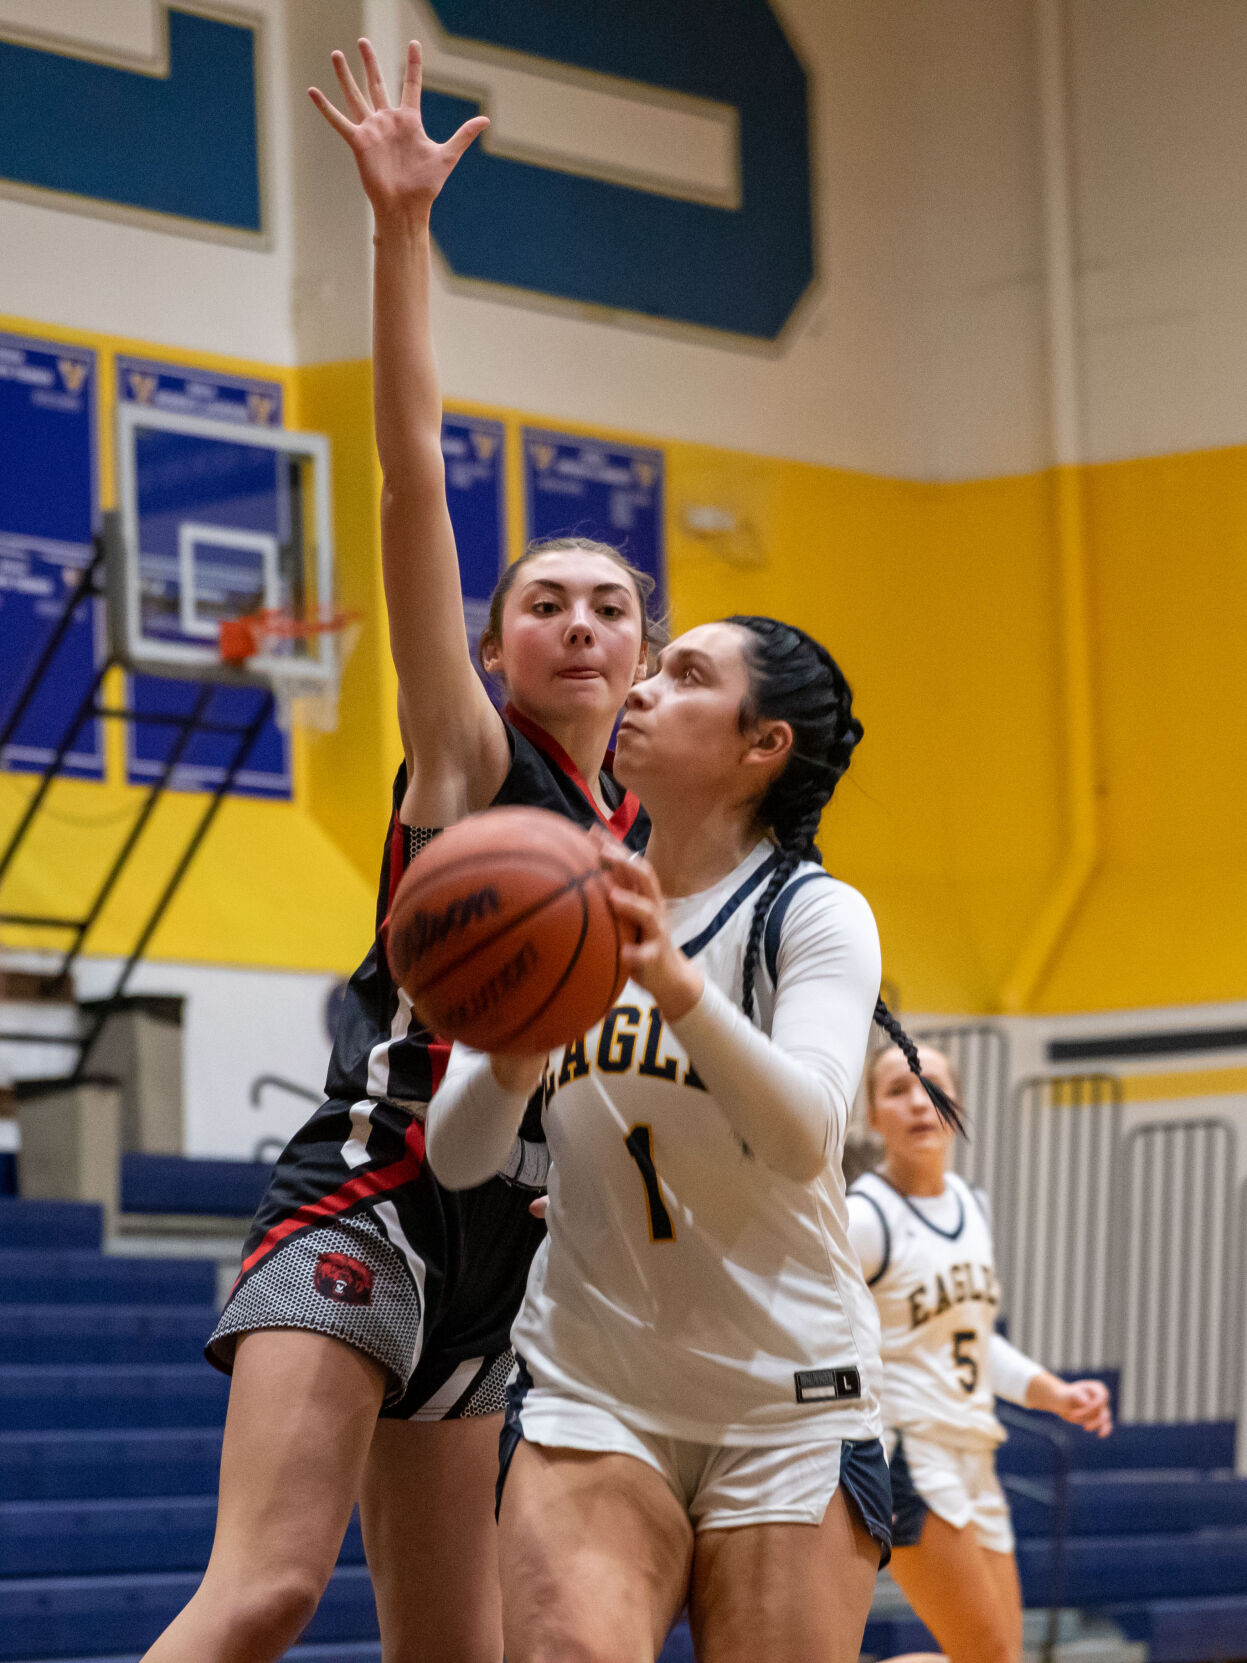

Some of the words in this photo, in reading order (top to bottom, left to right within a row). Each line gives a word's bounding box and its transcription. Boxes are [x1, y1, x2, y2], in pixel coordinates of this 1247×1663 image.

[623, 1121, 676, 1244] 1
[843, 1375, 853, 1391] L
[951, 1328, 979, 1393] 5
